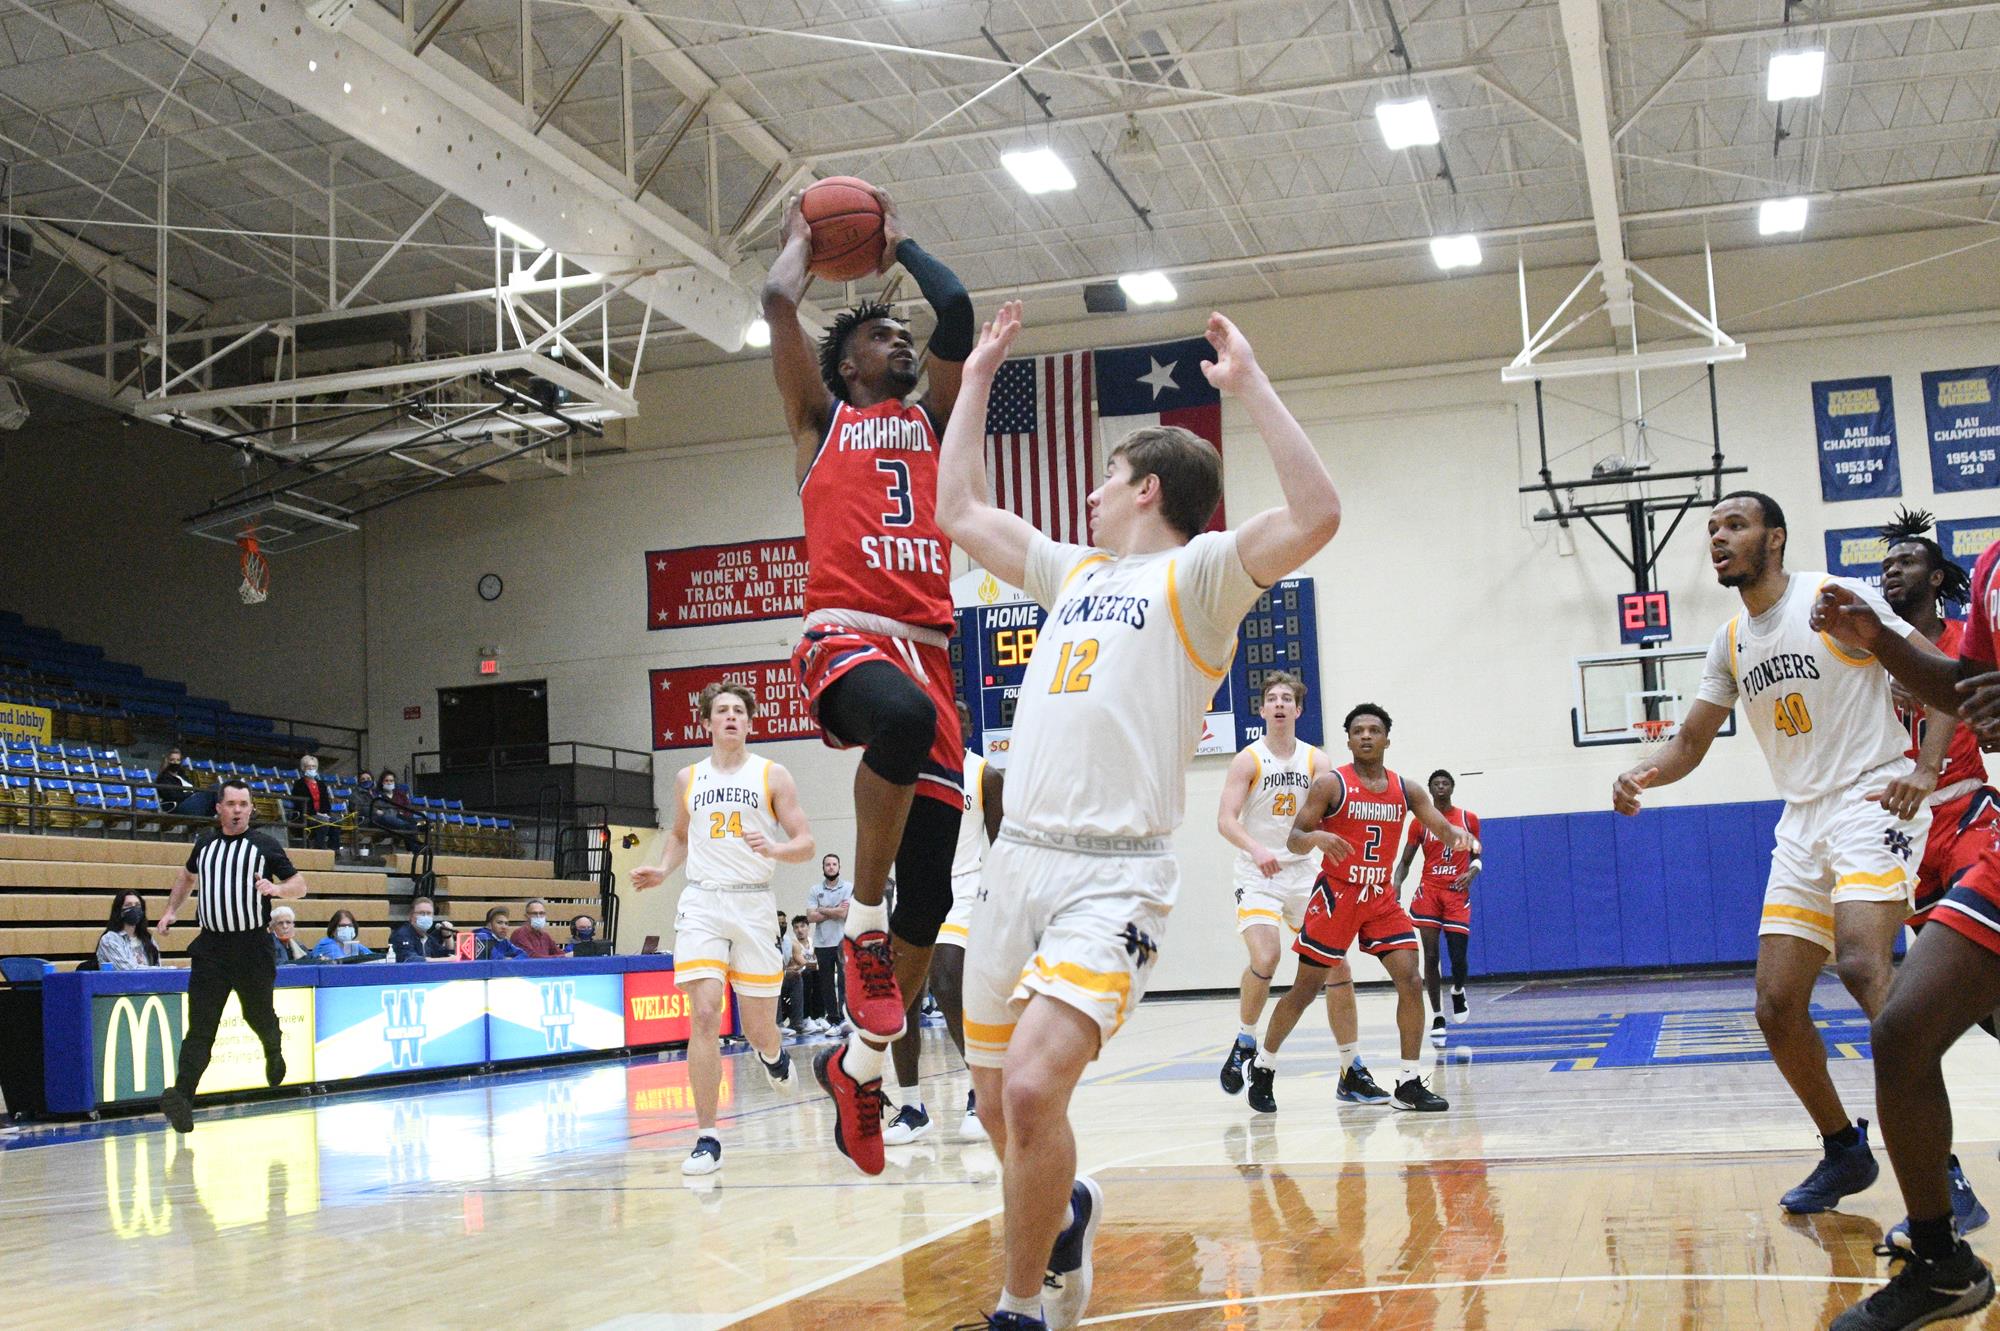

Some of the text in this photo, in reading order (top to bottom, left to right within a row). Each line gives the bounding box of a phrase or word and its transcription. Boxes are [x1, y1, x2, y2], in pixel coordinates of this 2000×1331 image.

[839, 416, 932, 452] PANHANDL
[1843, 427, 1868, 438] AAU
[1934, 426, 2000, 442] CHAMPIONS
[1955, 417, 1979, 429] AAU
[1823, 435, 1891, 451] CHAMPIONS
[875, 458, 915, 527] 3
[717, 546, 796, 568] 2016 NAIA
[861, 536, 943, 575] STATE
[691, 566, 758, 586] WOMEN'S
[1280, 581, 1299, 589] FOULS
[685, 578, 807, 603] TRACK AND FIE
[678, 602, 753, 620] NATIONAL
[985, 605, 1039, 629] HOME
[1049, 595, 1149, 640] IONEERS
[1623, 593, 1667, 629] 27
[1048, 638, 1100, 694] 12
[1742, 653, 1820, 702] PIONEERS
[722, 671, 757, 686] 2015
[16, 709, 44, 732] lobby
[1774, 692, 1812, 737] 40
[1263, 771, 1309, 791] PIONEERS
[694, 787, 758, 811] PIONEERS
[1272, 793, 1297, 816] 23
[1348, 801, 1403, 822] PANHANDLE
[710, 811, 744, 839] 24
[1363, 825, 1382, 862] 2
[631, 994, 680, 1021] WELLS
